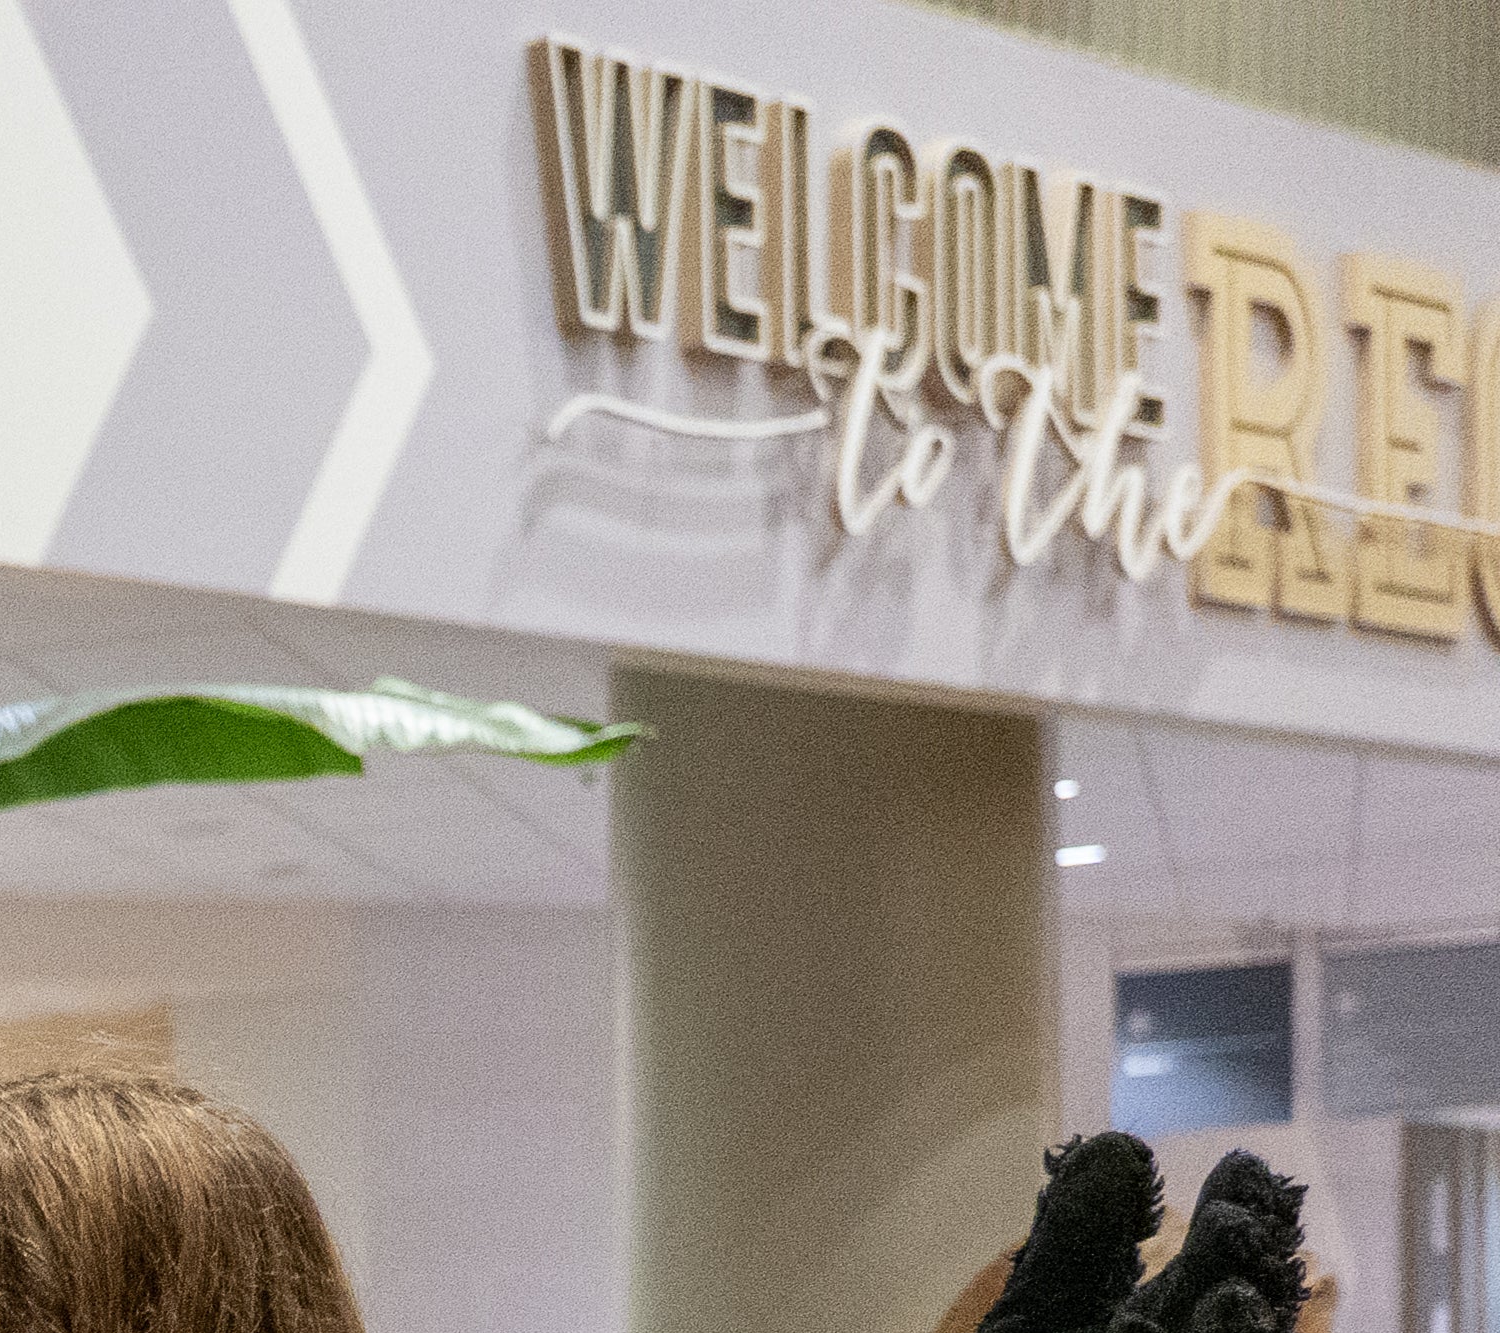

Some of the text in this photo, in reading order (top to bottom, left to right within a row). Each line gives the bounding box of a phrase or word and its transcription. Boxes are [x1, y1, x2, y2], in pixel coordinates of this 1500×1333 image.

[526, 32, 1169, 442] WELCOME
[1182, 210, 1500, 658] RE
[806, 330, 1216, 580] to the
